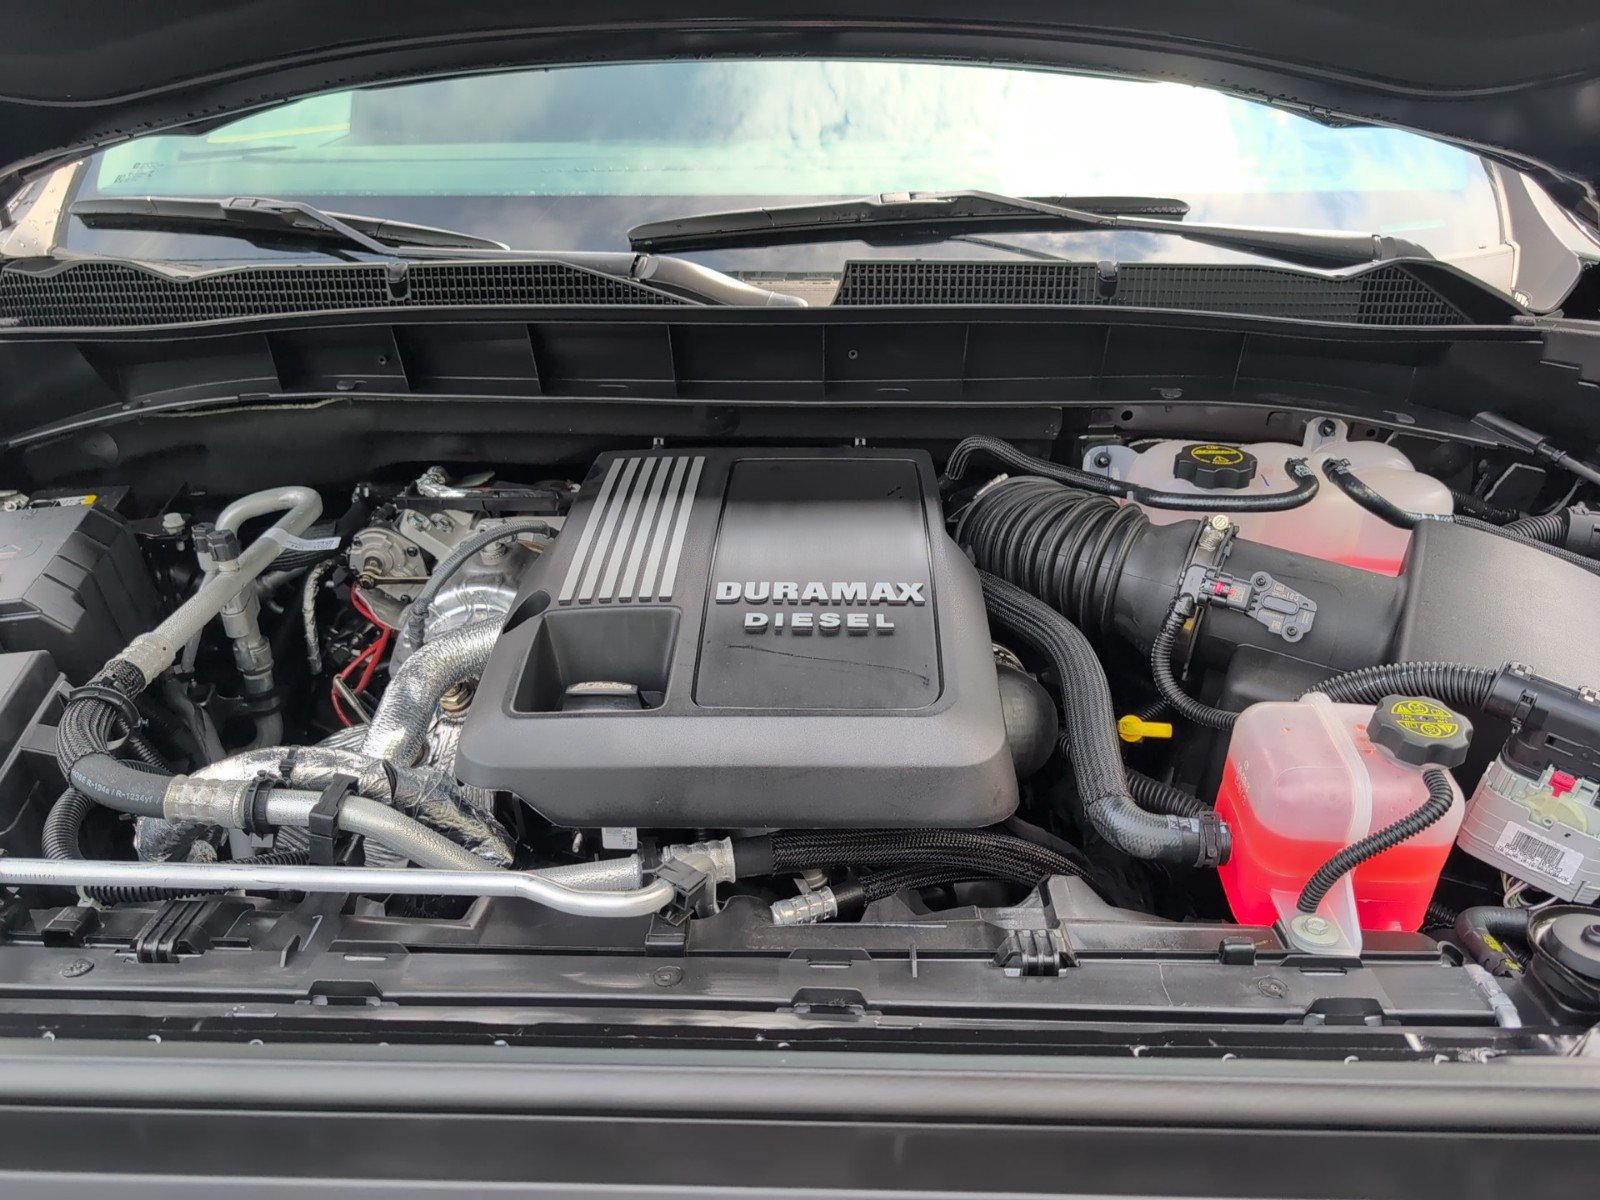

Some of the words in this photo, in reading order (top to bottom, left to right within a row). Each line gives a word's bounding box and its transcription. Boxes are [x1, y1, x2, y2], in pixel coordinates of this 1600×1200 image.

[715, 581, 926, 606] DURAMAX
[744, 612, 895, 634] DIESEL
[571, 681, 632, 691] ACDelco
